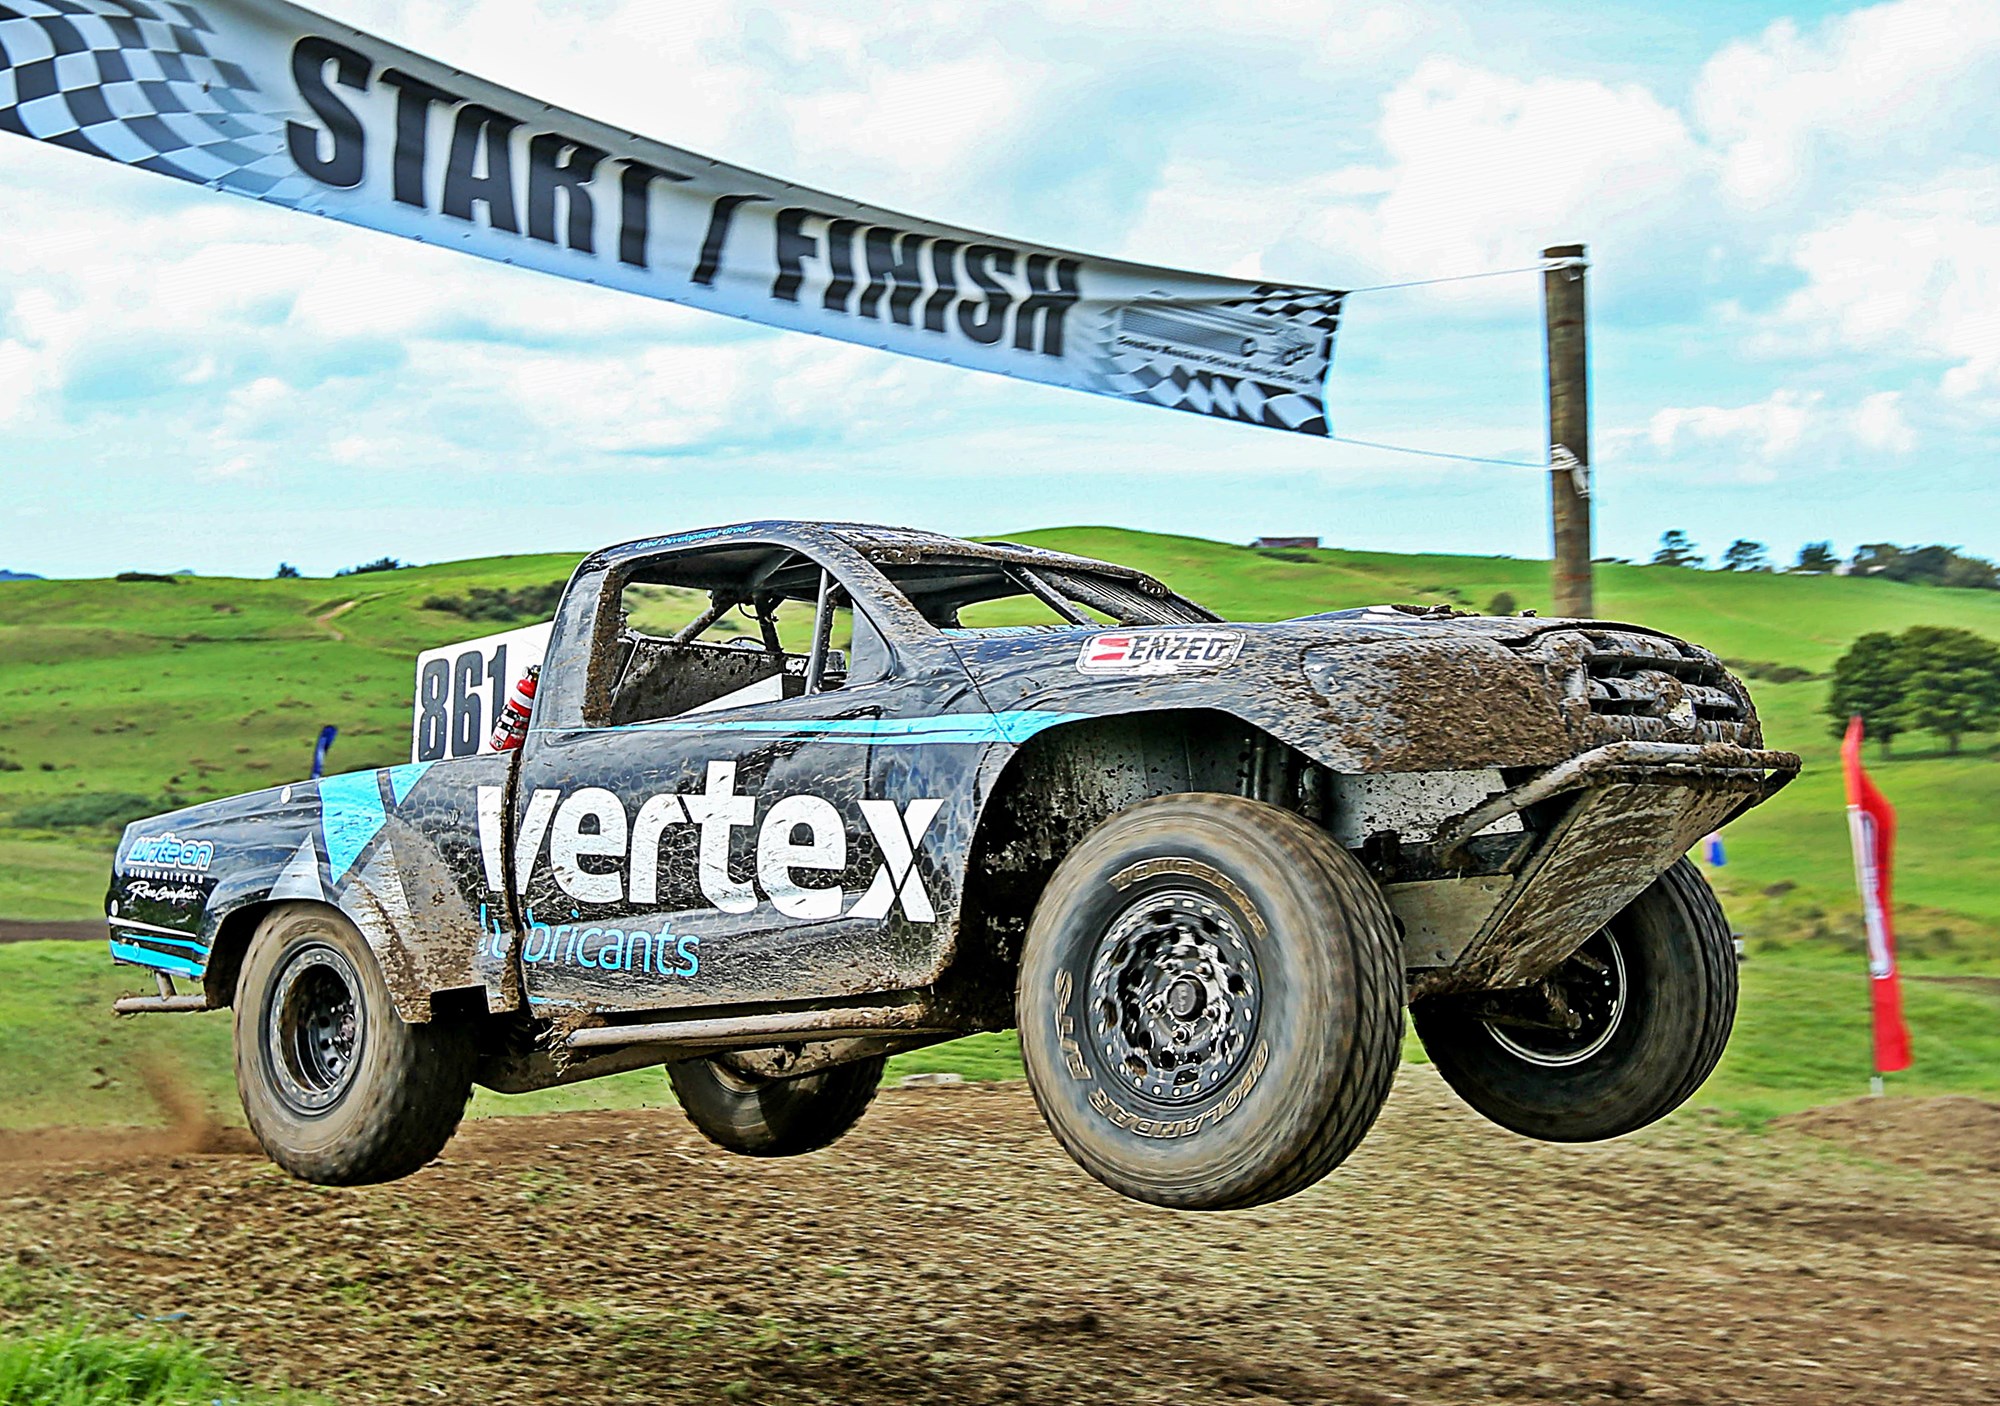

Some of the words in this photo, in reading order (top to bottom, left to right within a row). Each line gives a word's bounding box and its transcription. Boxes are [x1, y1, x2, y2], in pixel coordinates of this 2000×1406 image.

[287, 36, 693, 269] START
[771, 208, 1082, 356] FINISH
[1128, 636, 1225, 661] ENZED
[418, 644, 507, 762] 861
[129, 868, 204, 884] SIGNWRITERS
[476, 760, 944, 923] vertex
[478, 902, 700, 978] lubricants
